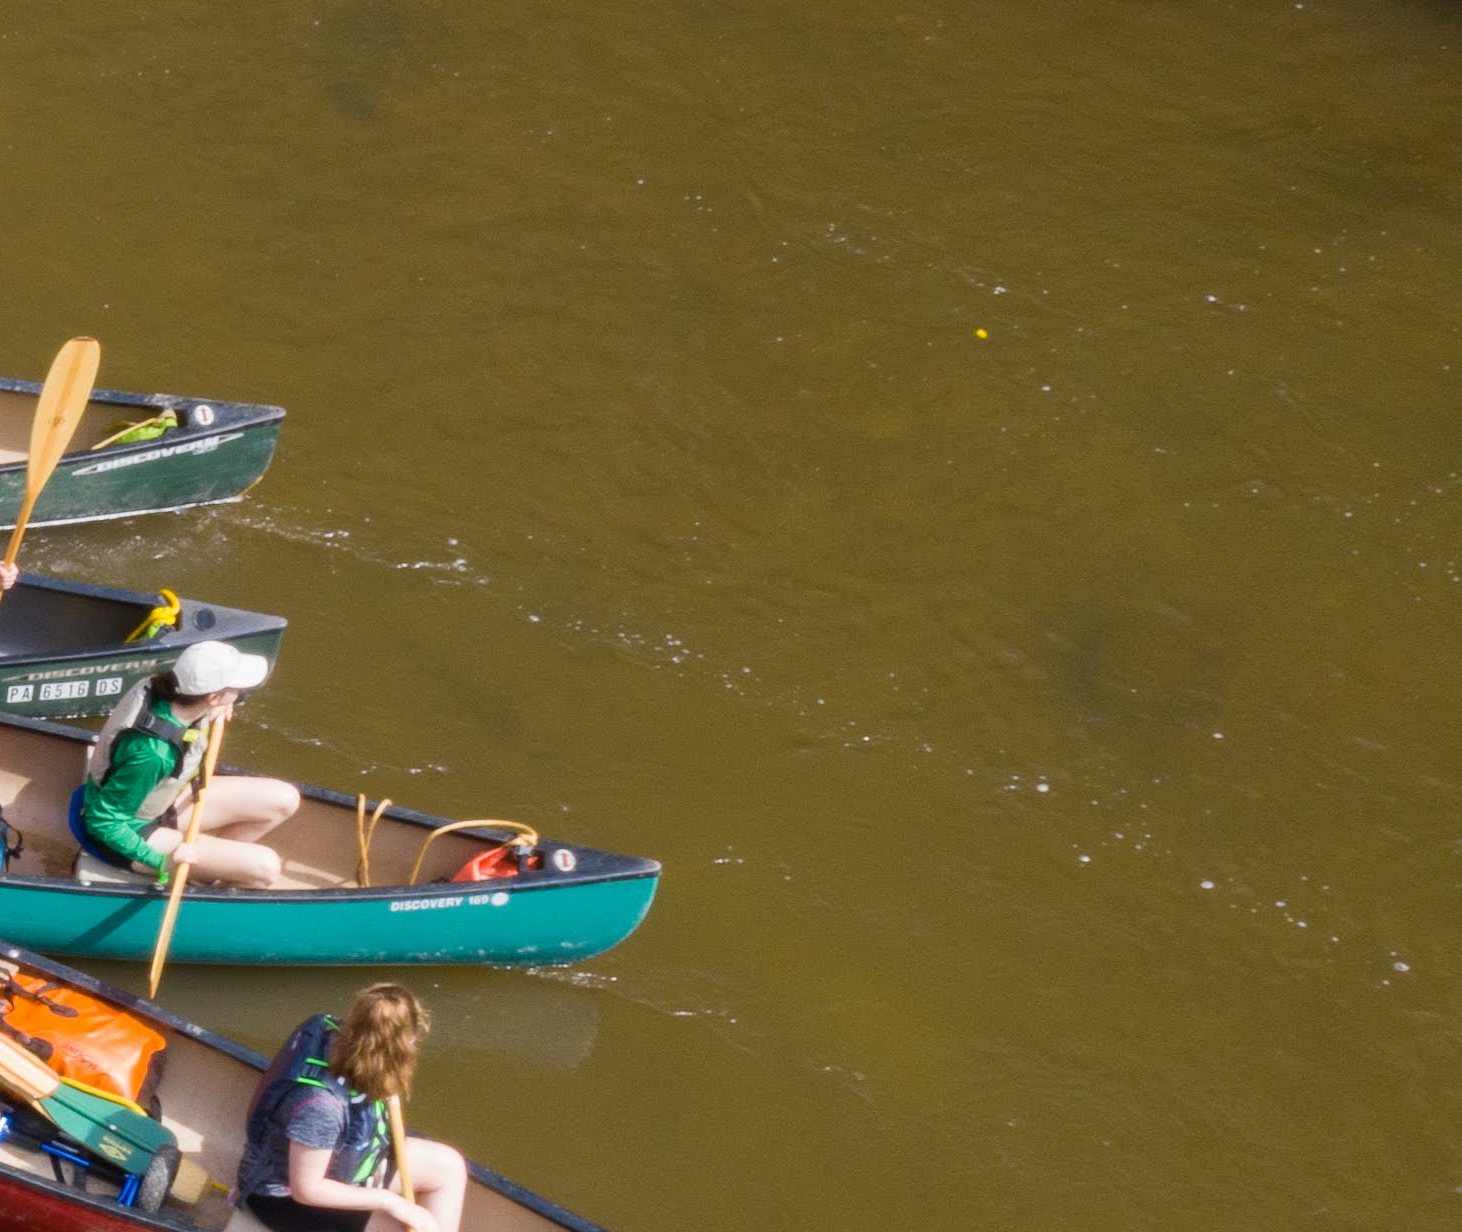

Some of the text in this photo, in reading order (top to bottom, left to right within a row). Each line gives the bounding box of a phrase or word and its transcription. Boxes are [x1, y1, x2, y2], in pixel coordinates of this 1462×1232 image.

[28, 658, 157, 682] DISCOVERY
[9, 678, 120, 702] PA 6516 DS
[390, 896, 464, 912] DISCOVERY
